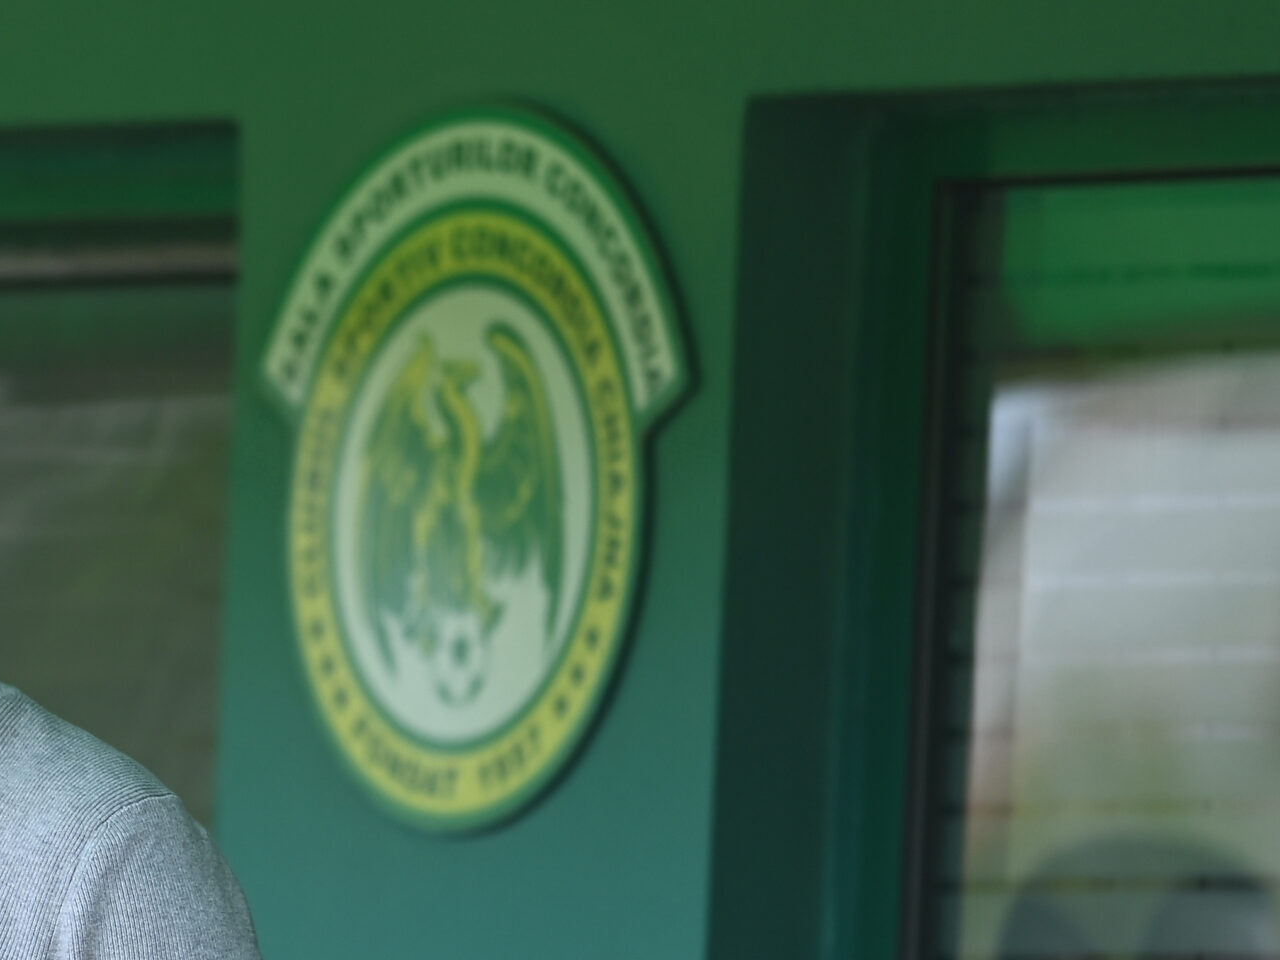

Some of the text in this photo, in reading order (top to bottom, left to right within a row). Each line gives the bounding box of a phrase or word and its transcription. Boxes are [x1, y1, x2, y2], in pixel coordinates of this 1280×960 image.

[330, 136, 541, 265] SPORTURILOR
[543, 160, 663, 388] CONCORDIA
[448, 226, 604, 368] CONCORDIA
[596, 376, 628, 600] CHIAJNA
